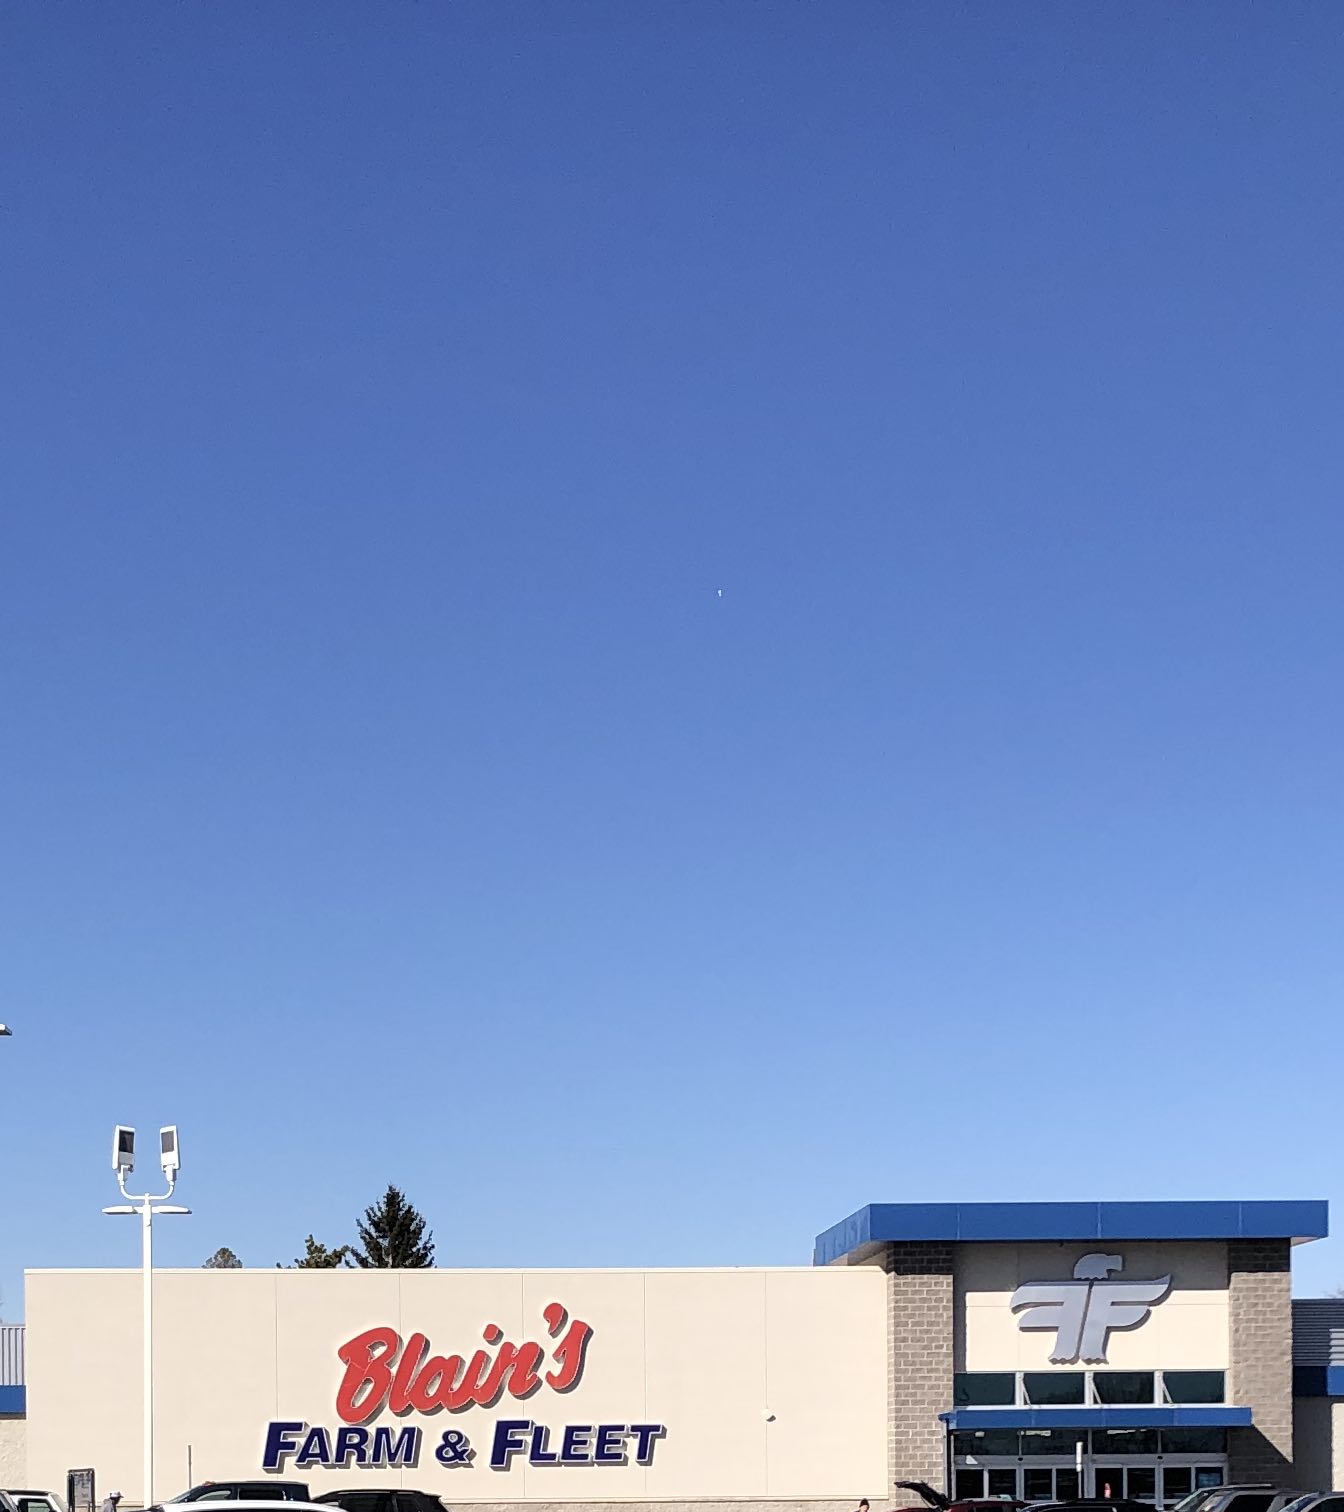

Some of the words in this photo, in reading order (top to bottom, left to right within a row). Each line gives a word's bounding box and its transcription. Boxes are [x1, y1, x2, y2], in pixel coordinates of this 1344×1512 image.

[336, 1302, 591, 1425] Blain's
[262, 1421, 420, 1471] FARM
[435, 1429, 475, 1467] &
[490, 1419, 665, 1470] FLEET
